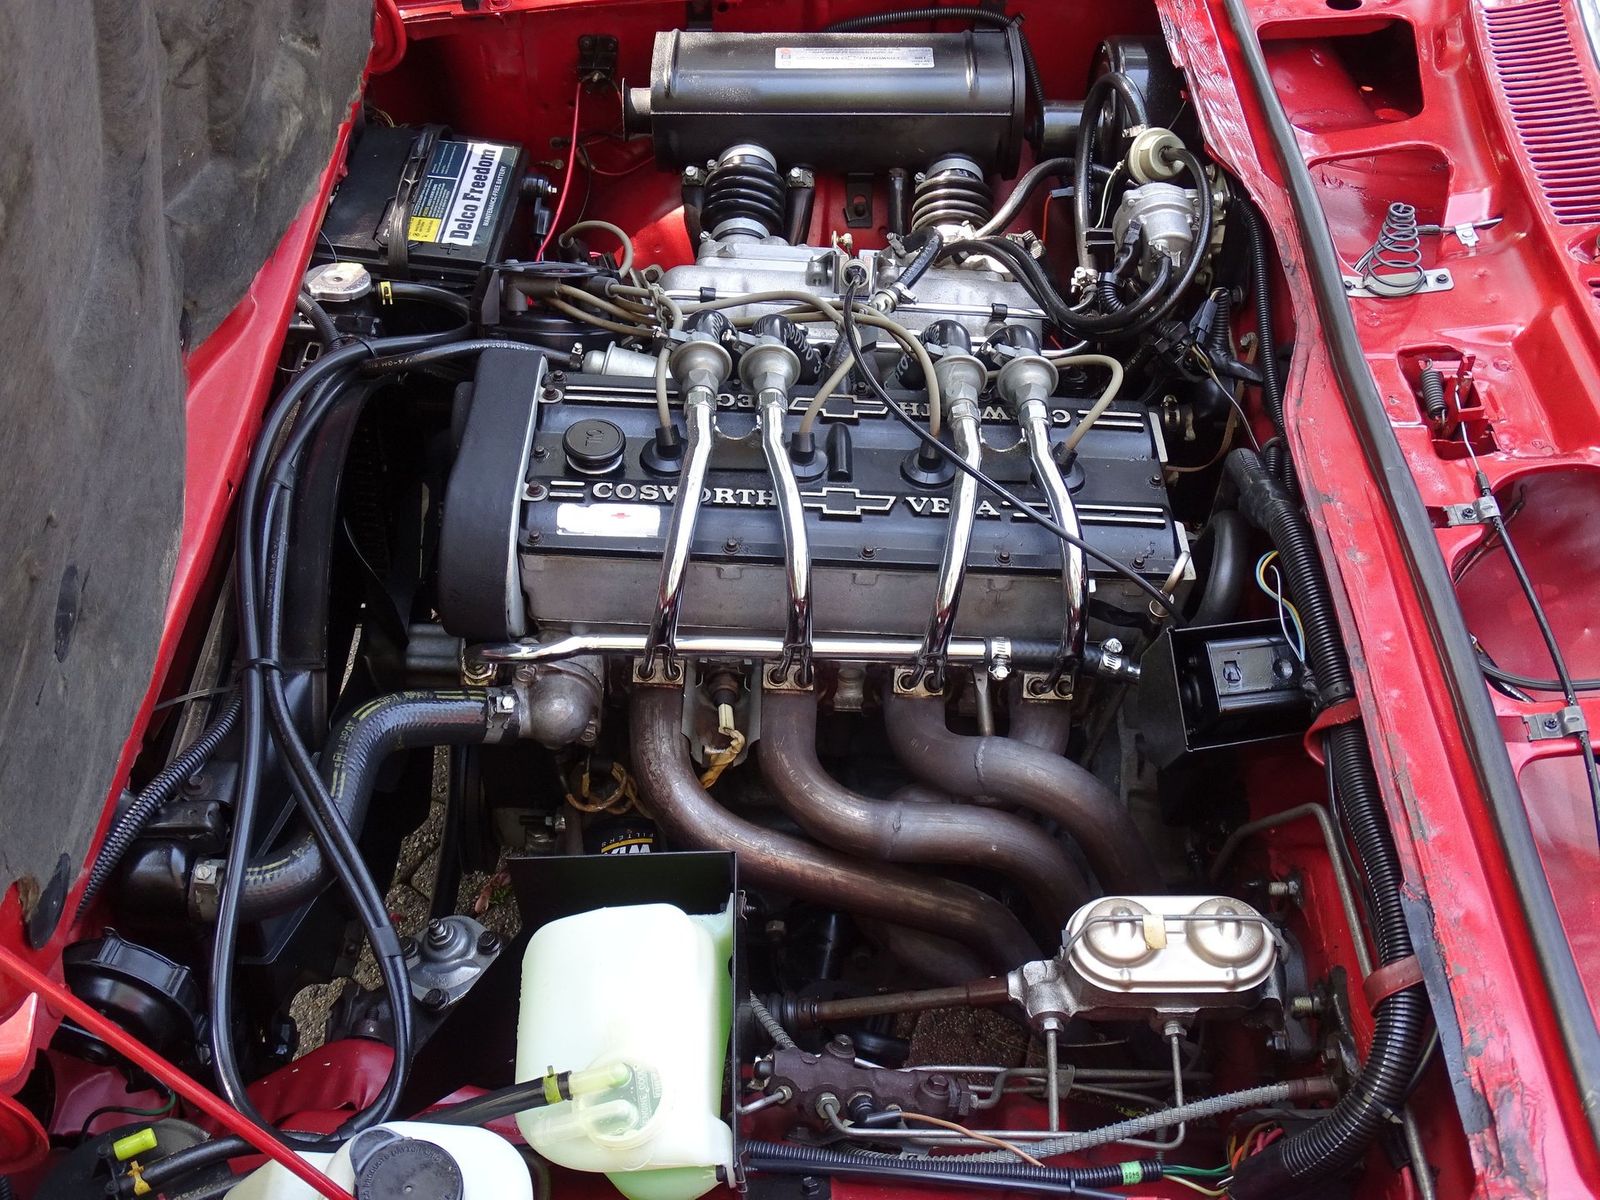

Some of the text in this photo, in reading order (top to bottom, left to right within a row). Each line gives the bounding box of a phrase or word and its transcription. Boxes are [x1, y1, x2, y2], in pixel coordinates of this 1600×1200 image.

[497, 166, 507, 185] BATTERY
[449, 149, 496, 239] Delco Freedom
[905, 496, 1000, 515] VEA
